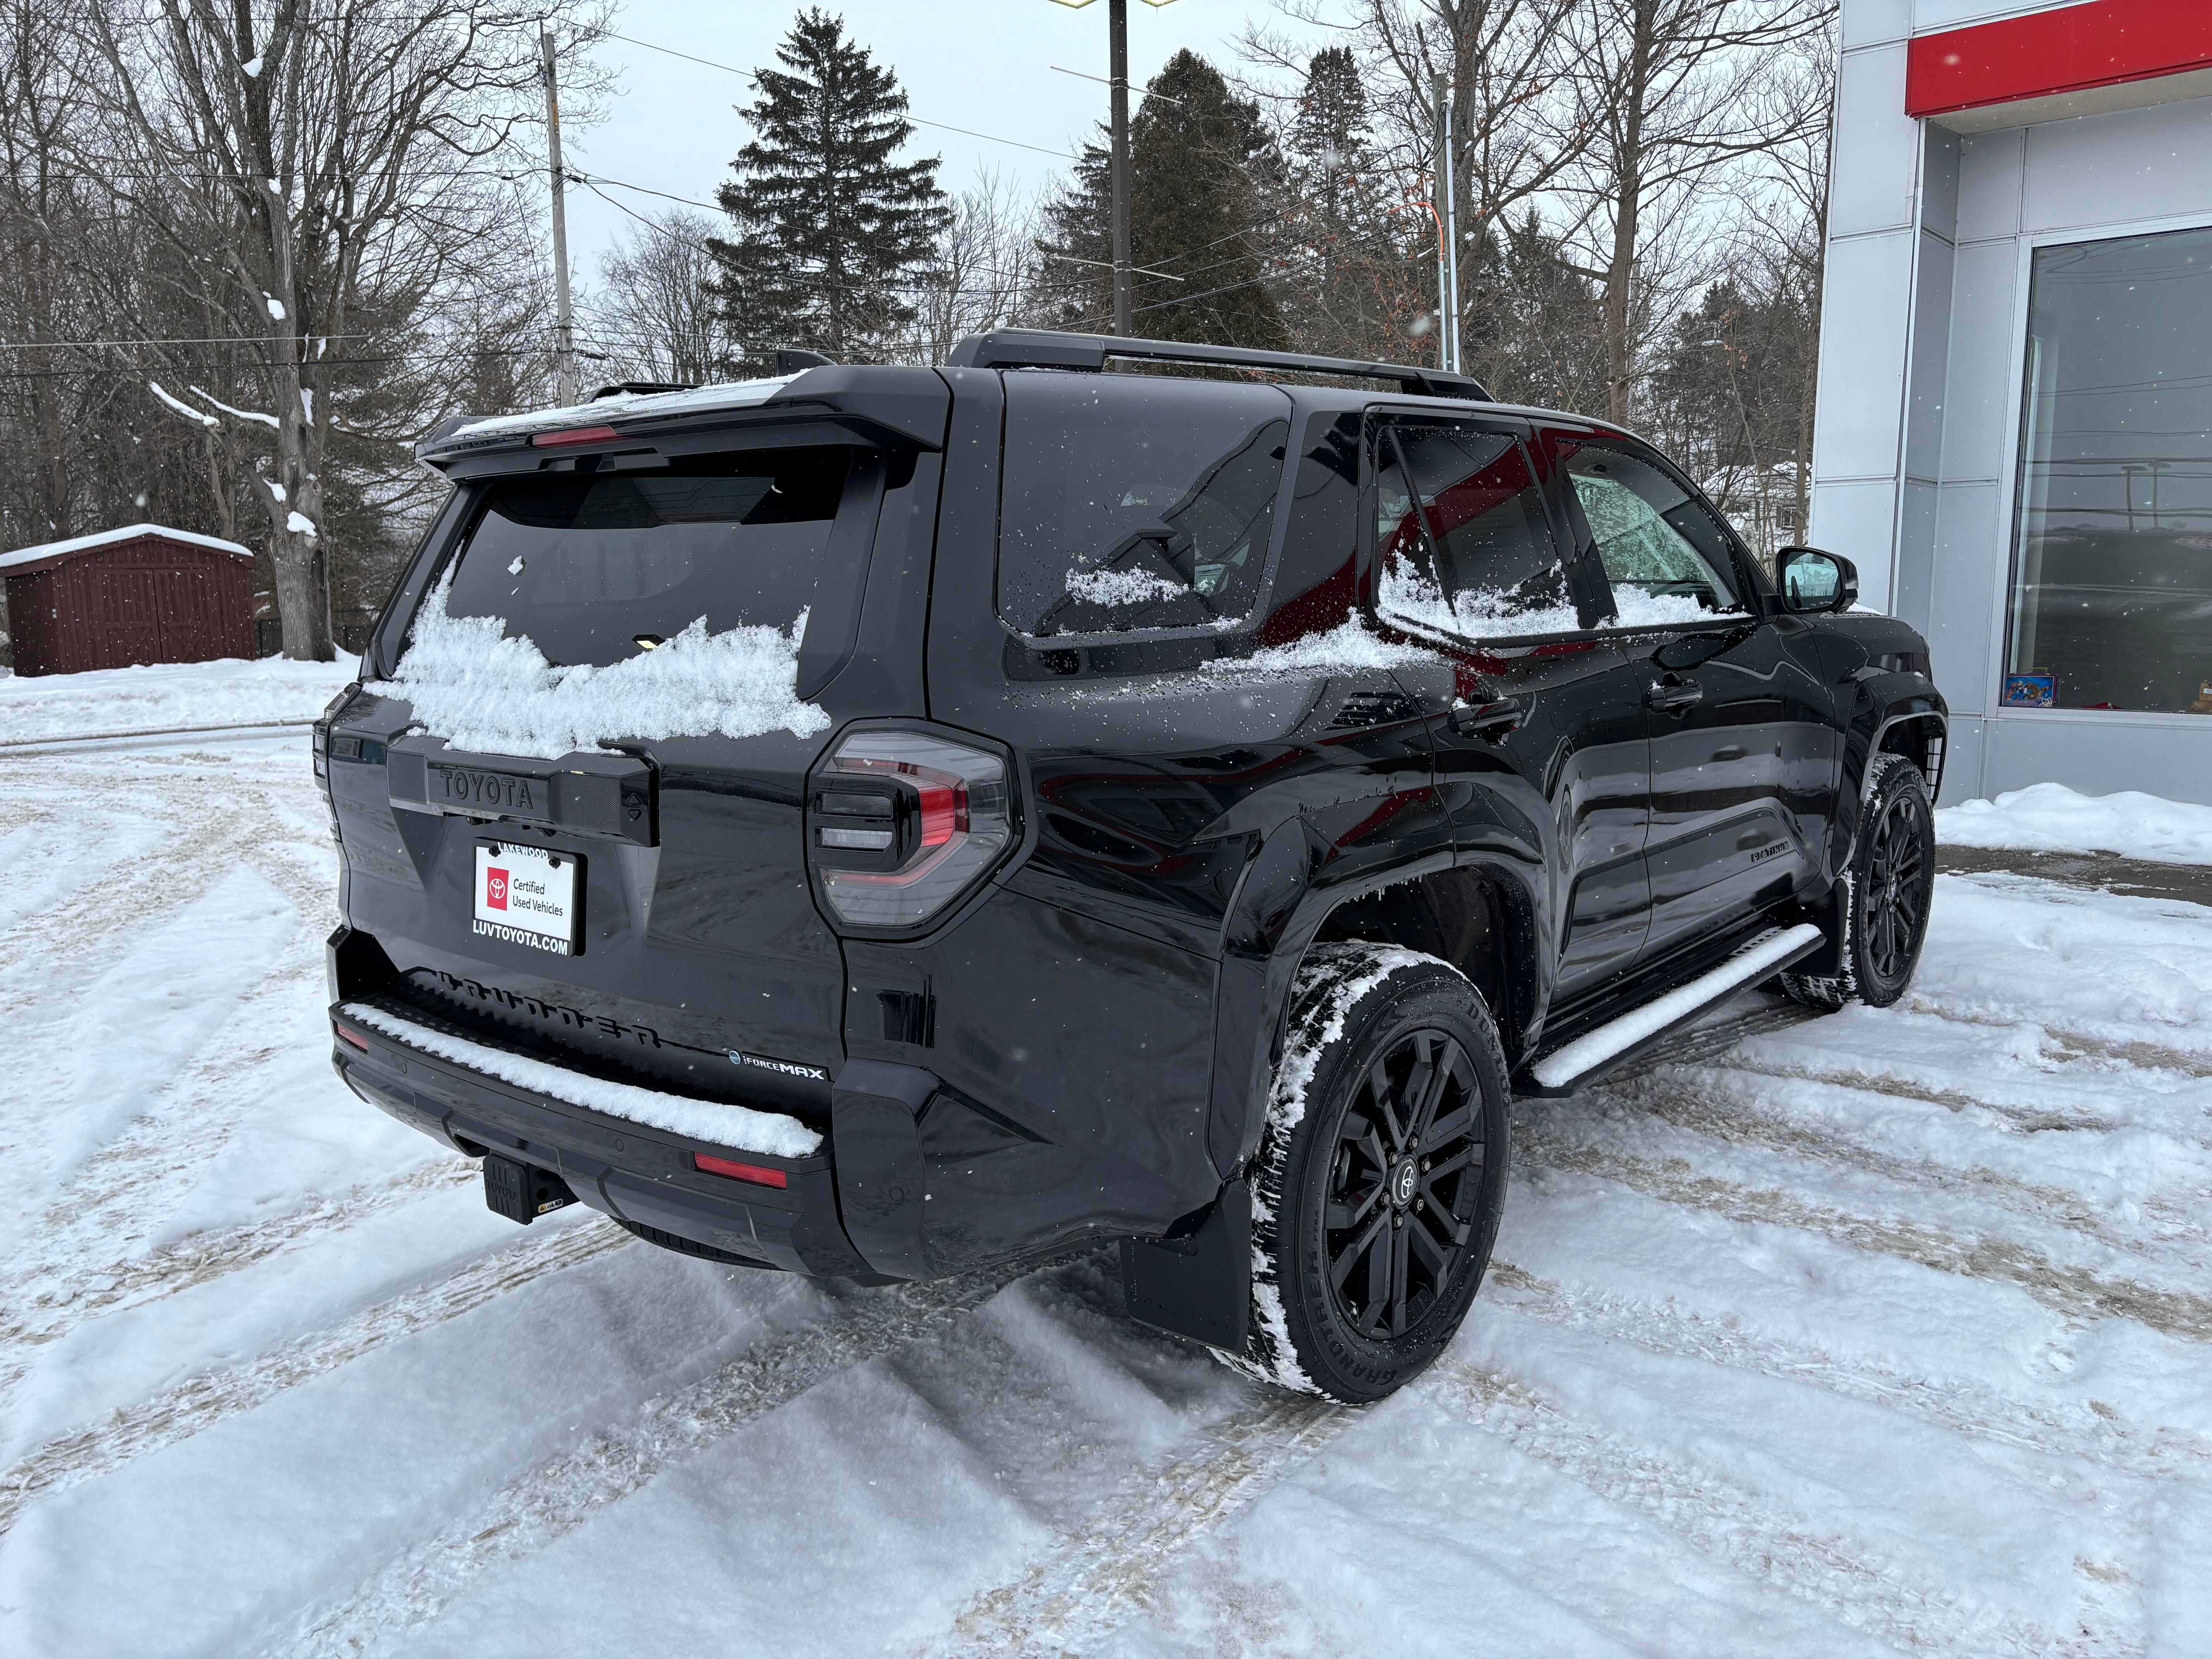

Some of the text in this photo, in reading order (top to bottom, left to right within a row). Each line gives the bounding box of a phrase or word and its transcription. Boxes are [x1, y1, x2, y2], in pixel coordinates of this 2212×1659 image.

[440, 770, 533, 809] TOYOTA
[497, 842, 548, 859] LAKEWOOD
[1751, 841, 1789, 862] PLATINUM
[514, 878, 545, 895] Certified
[513, 895, 563, 917] Used Vehicles
[473, 919, 568, 956] LUVTOYOTA.COM
